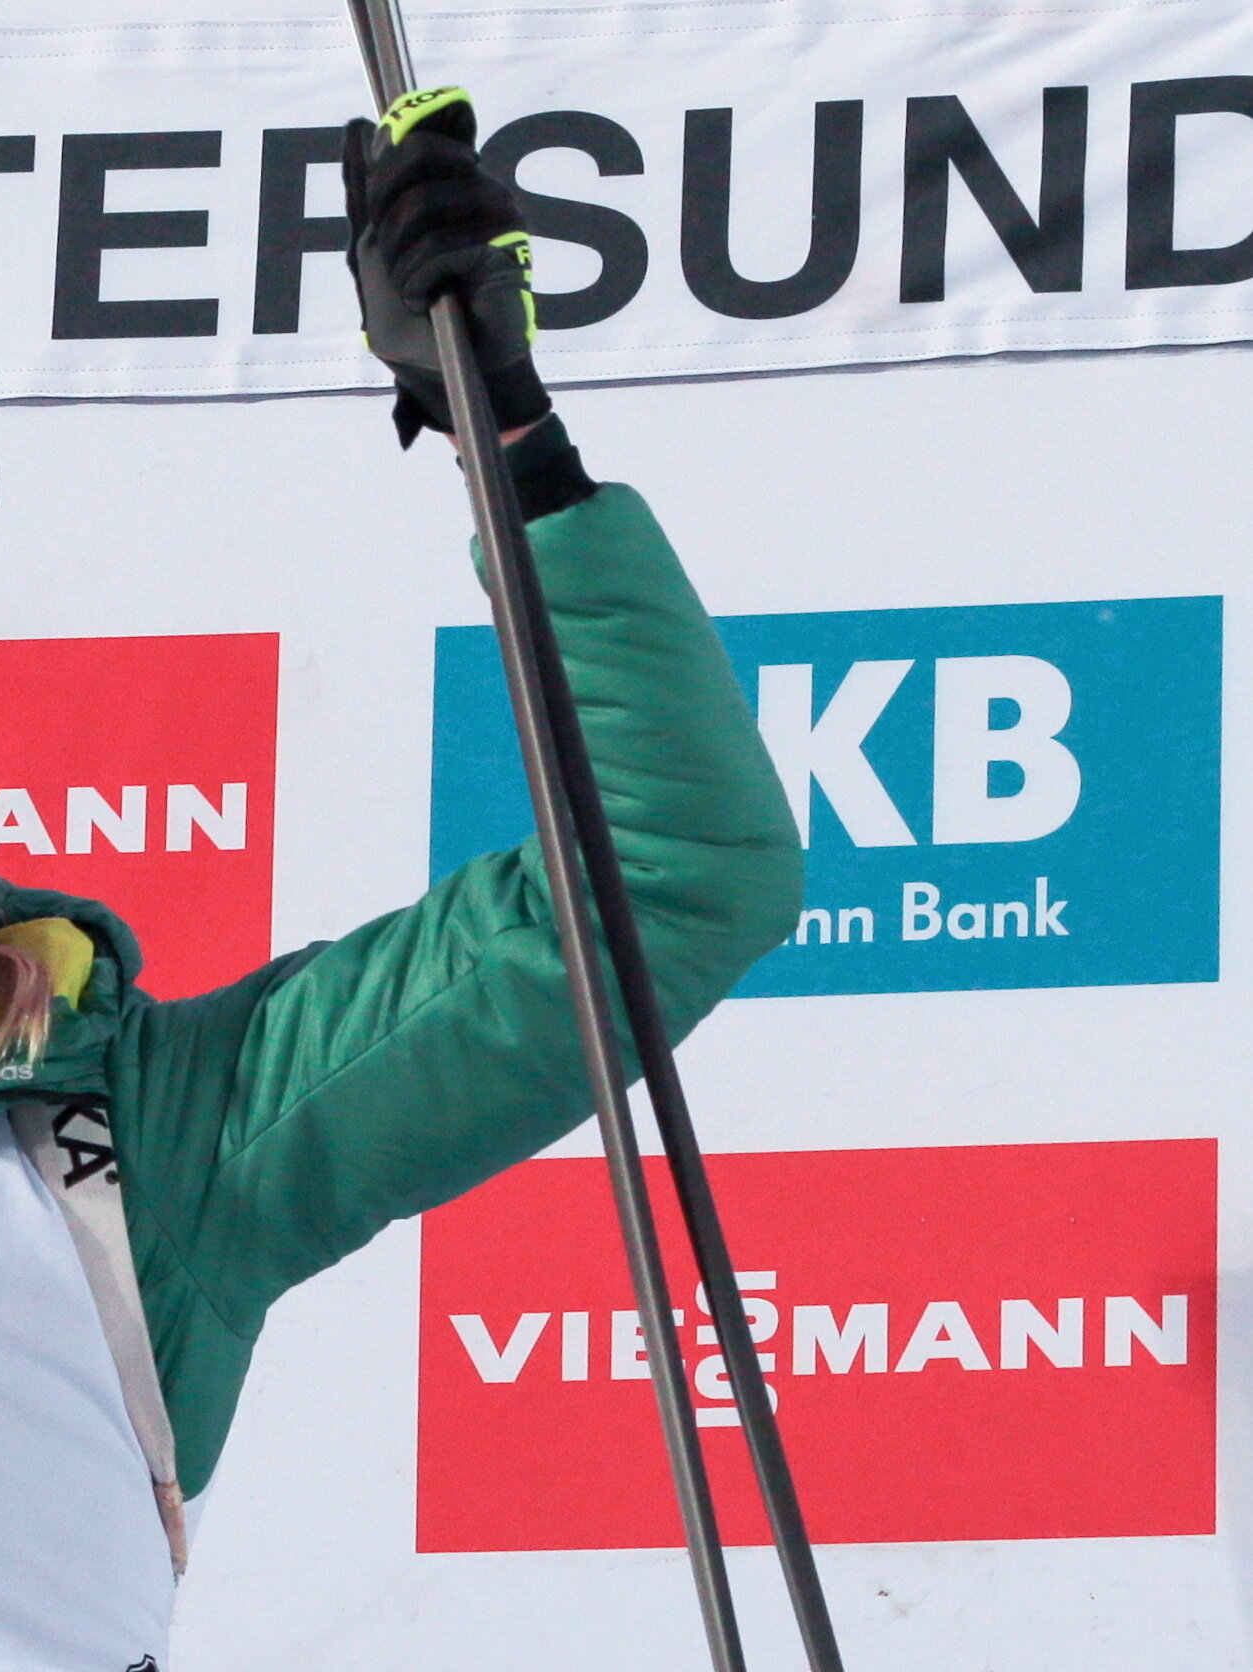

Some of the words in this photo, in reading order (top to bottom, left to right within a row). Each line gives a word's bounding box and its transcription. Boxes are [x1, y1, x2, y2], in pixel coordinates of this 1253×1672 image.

[757, 654, 1082, 850] KB
[782, 908, 875, 946] nn
[902, 876, 1071, 942] Bank
